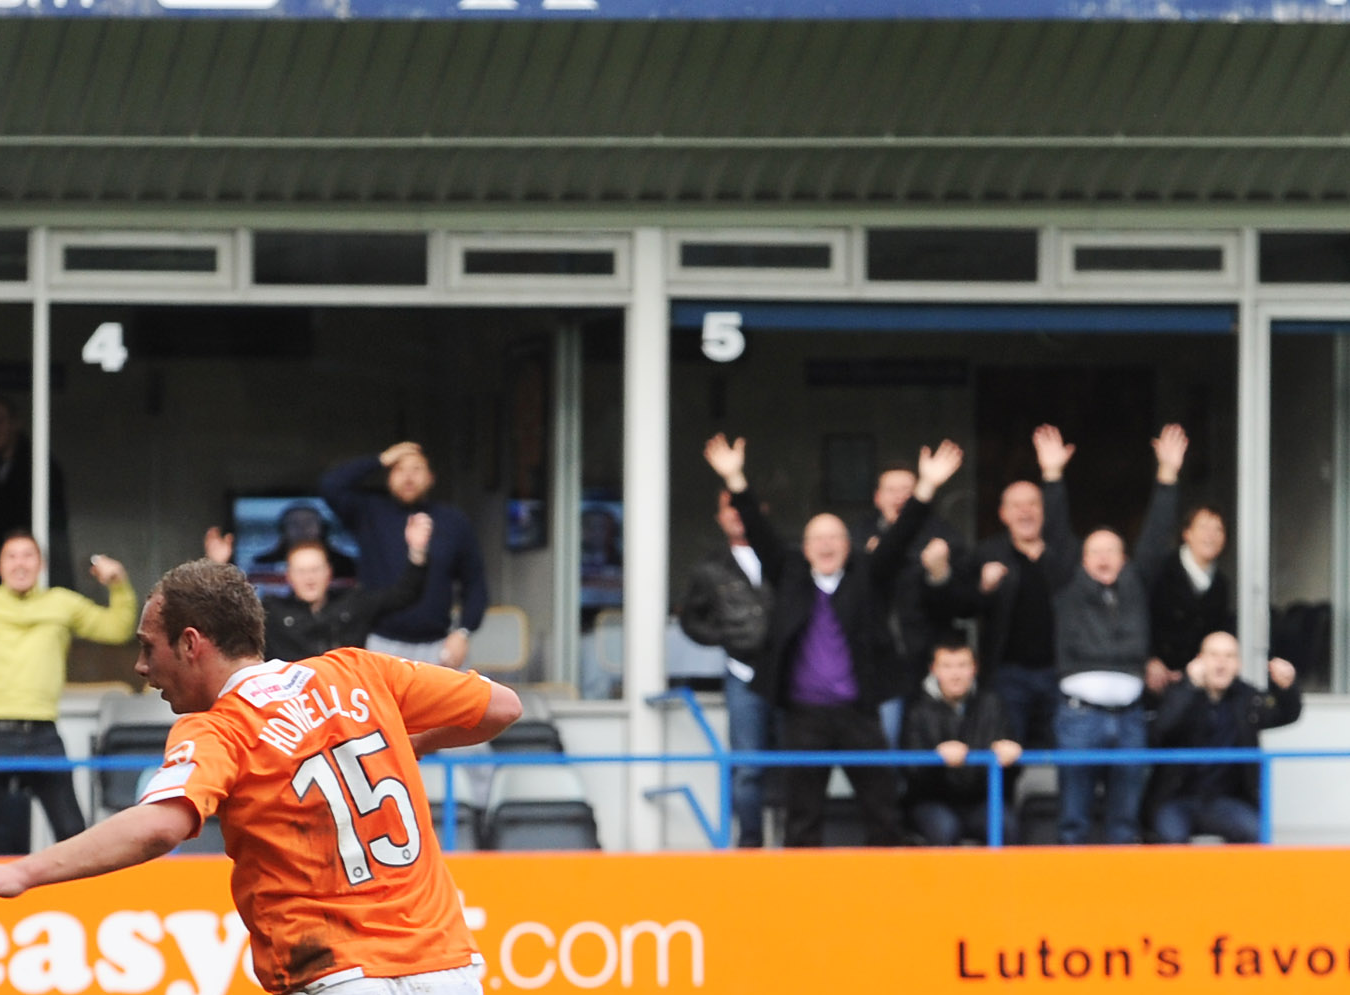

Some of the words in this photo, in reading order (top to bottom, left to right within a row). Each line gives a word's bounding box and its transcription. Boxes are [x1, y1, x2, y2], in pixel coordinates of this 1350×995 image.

[82, 322, 128, 372] 4
[702, 312, 745, 362] 5
[258, 685, 370, 755] HOWELLS
[291, 729, 422, 886] 15
[957, 936, 1181, 979] Luton's
[1211, 934, 1350, 978] favo
